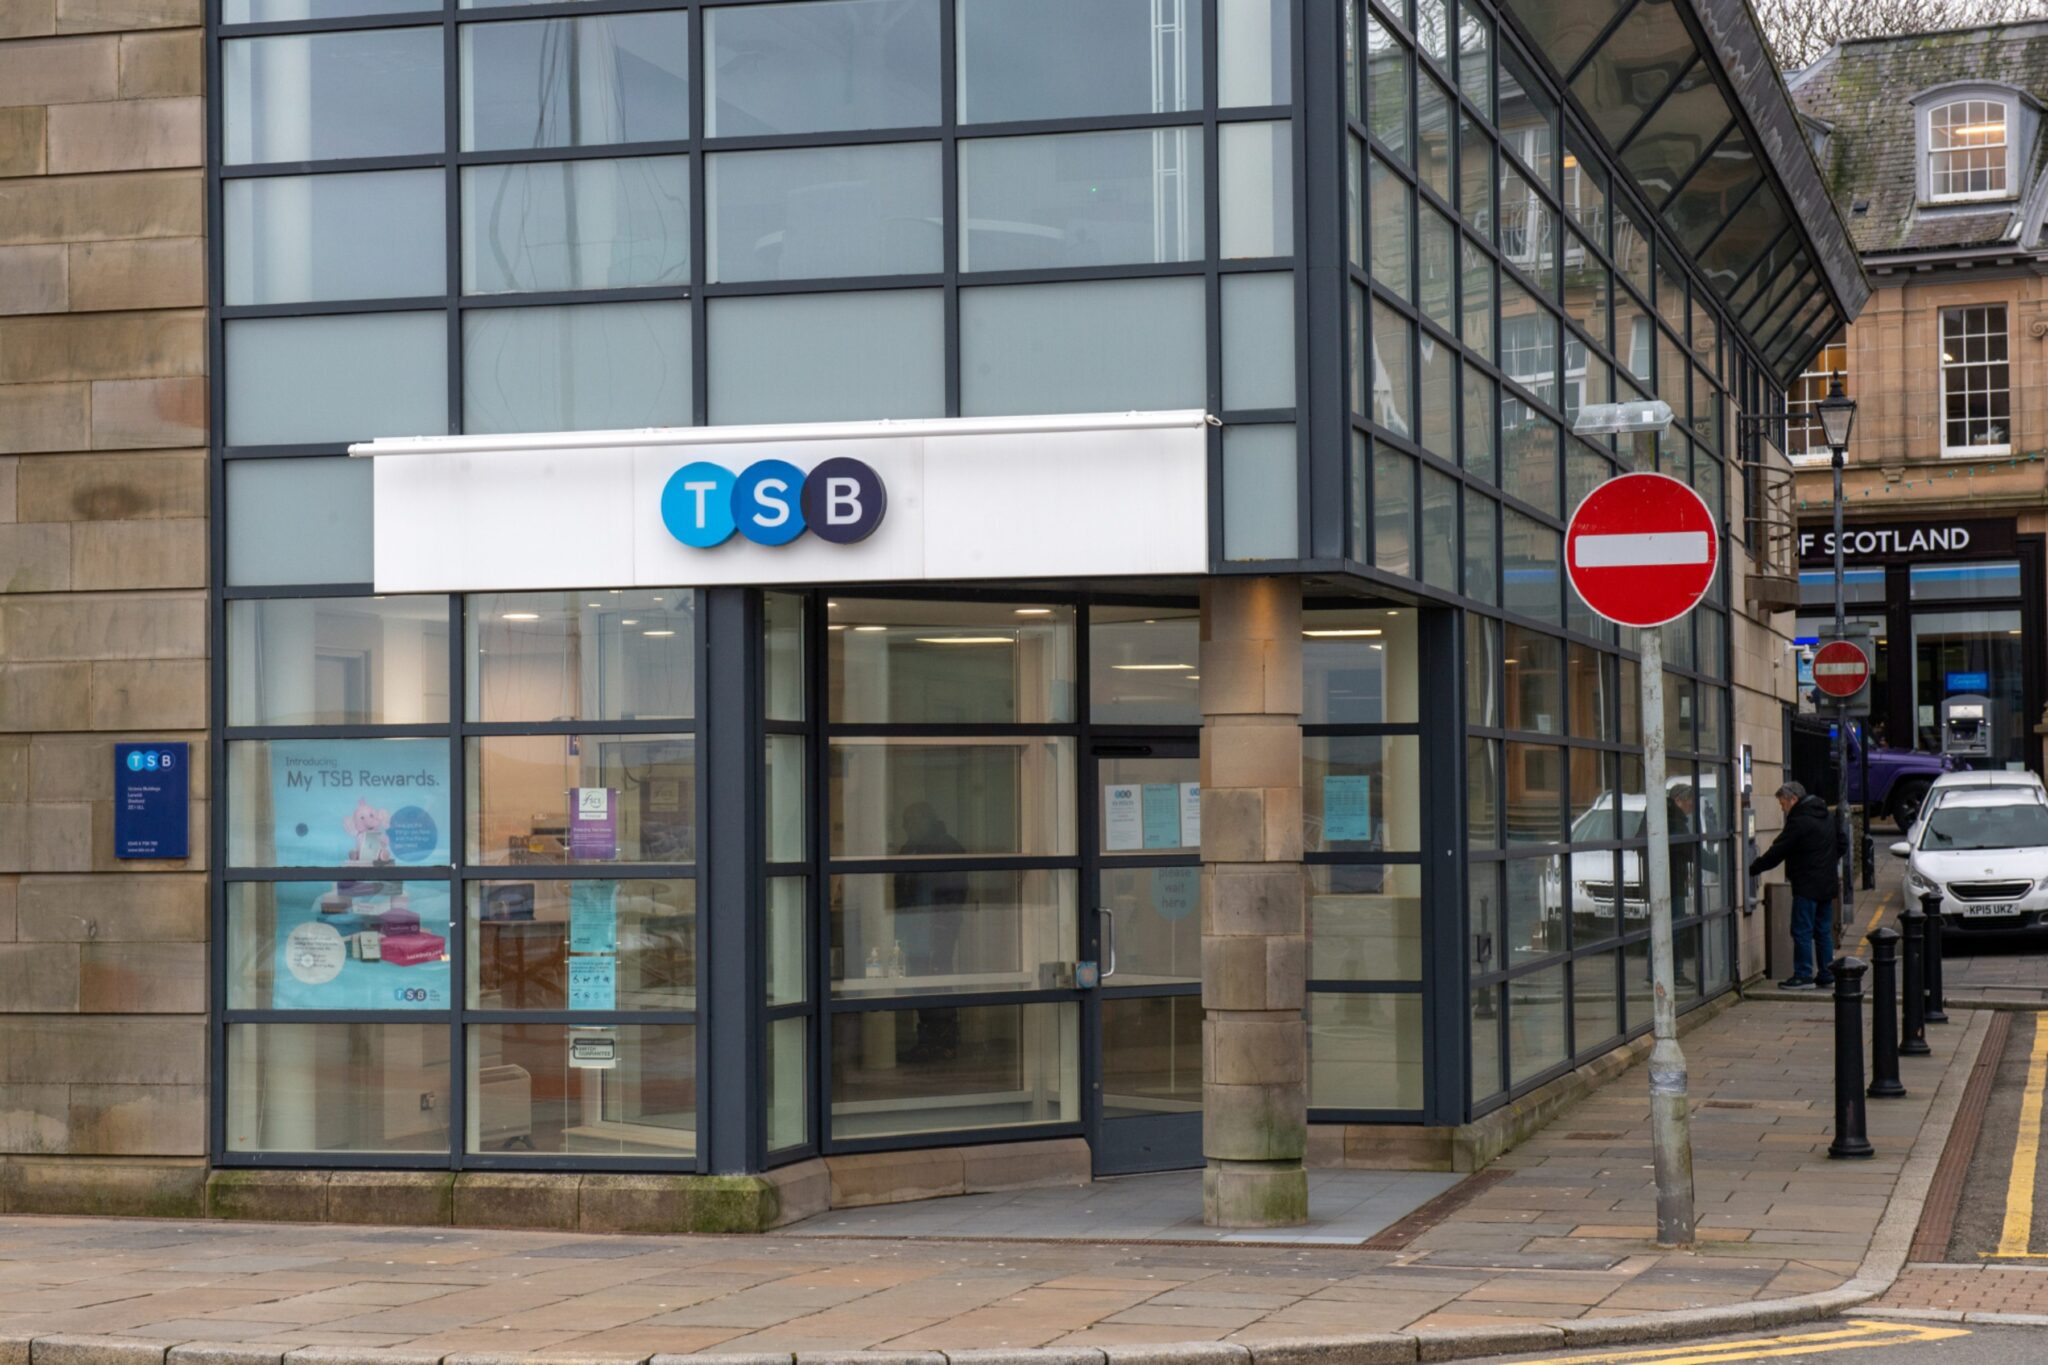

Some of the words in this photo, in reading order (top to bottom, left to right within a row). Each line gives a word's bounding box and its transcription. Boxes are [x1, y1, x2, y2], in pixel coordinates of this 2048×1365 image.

[683, 476, 864, 530] TSB
[1796, 534, 1815, 555] F
[1824, 527, 1970, 555] SCOTLAND
[132, 754, 172, 768] TSB
[285, 757, 338, 768] Introducing
[287, 770, 313, 791] My
[318, 770, 353, 787] TSB
[359, 769, 440, 787] Rewards.
[1969, 904, 1992, 915] KP15
[1993, 904, 2013, 914] UKZ
[397, 989, 425, 1001] TSB
